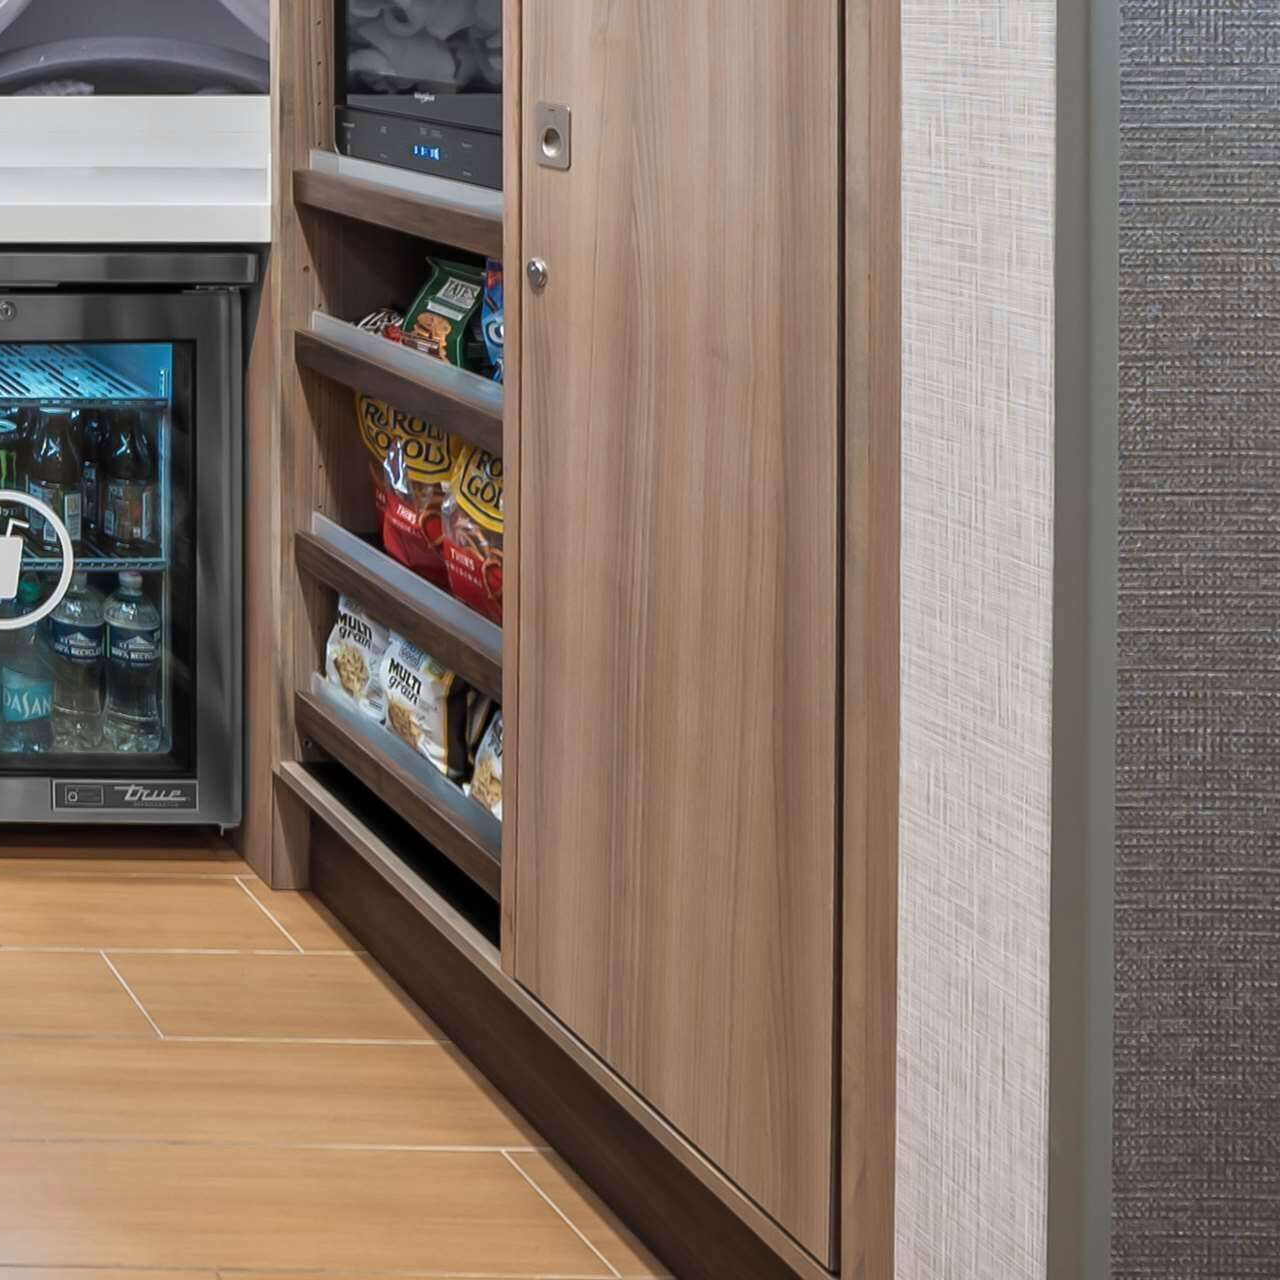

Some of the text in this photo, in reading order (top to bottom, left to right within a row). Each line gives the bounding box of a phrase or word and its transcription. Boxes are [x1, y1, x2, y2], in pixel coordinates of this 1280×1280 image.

[337, 610, 374, 641] MULTI
[339, 625, 372, 650] grain
[388, 657, 423, 696] MULTI
[388, 675, 420, 706] grain
